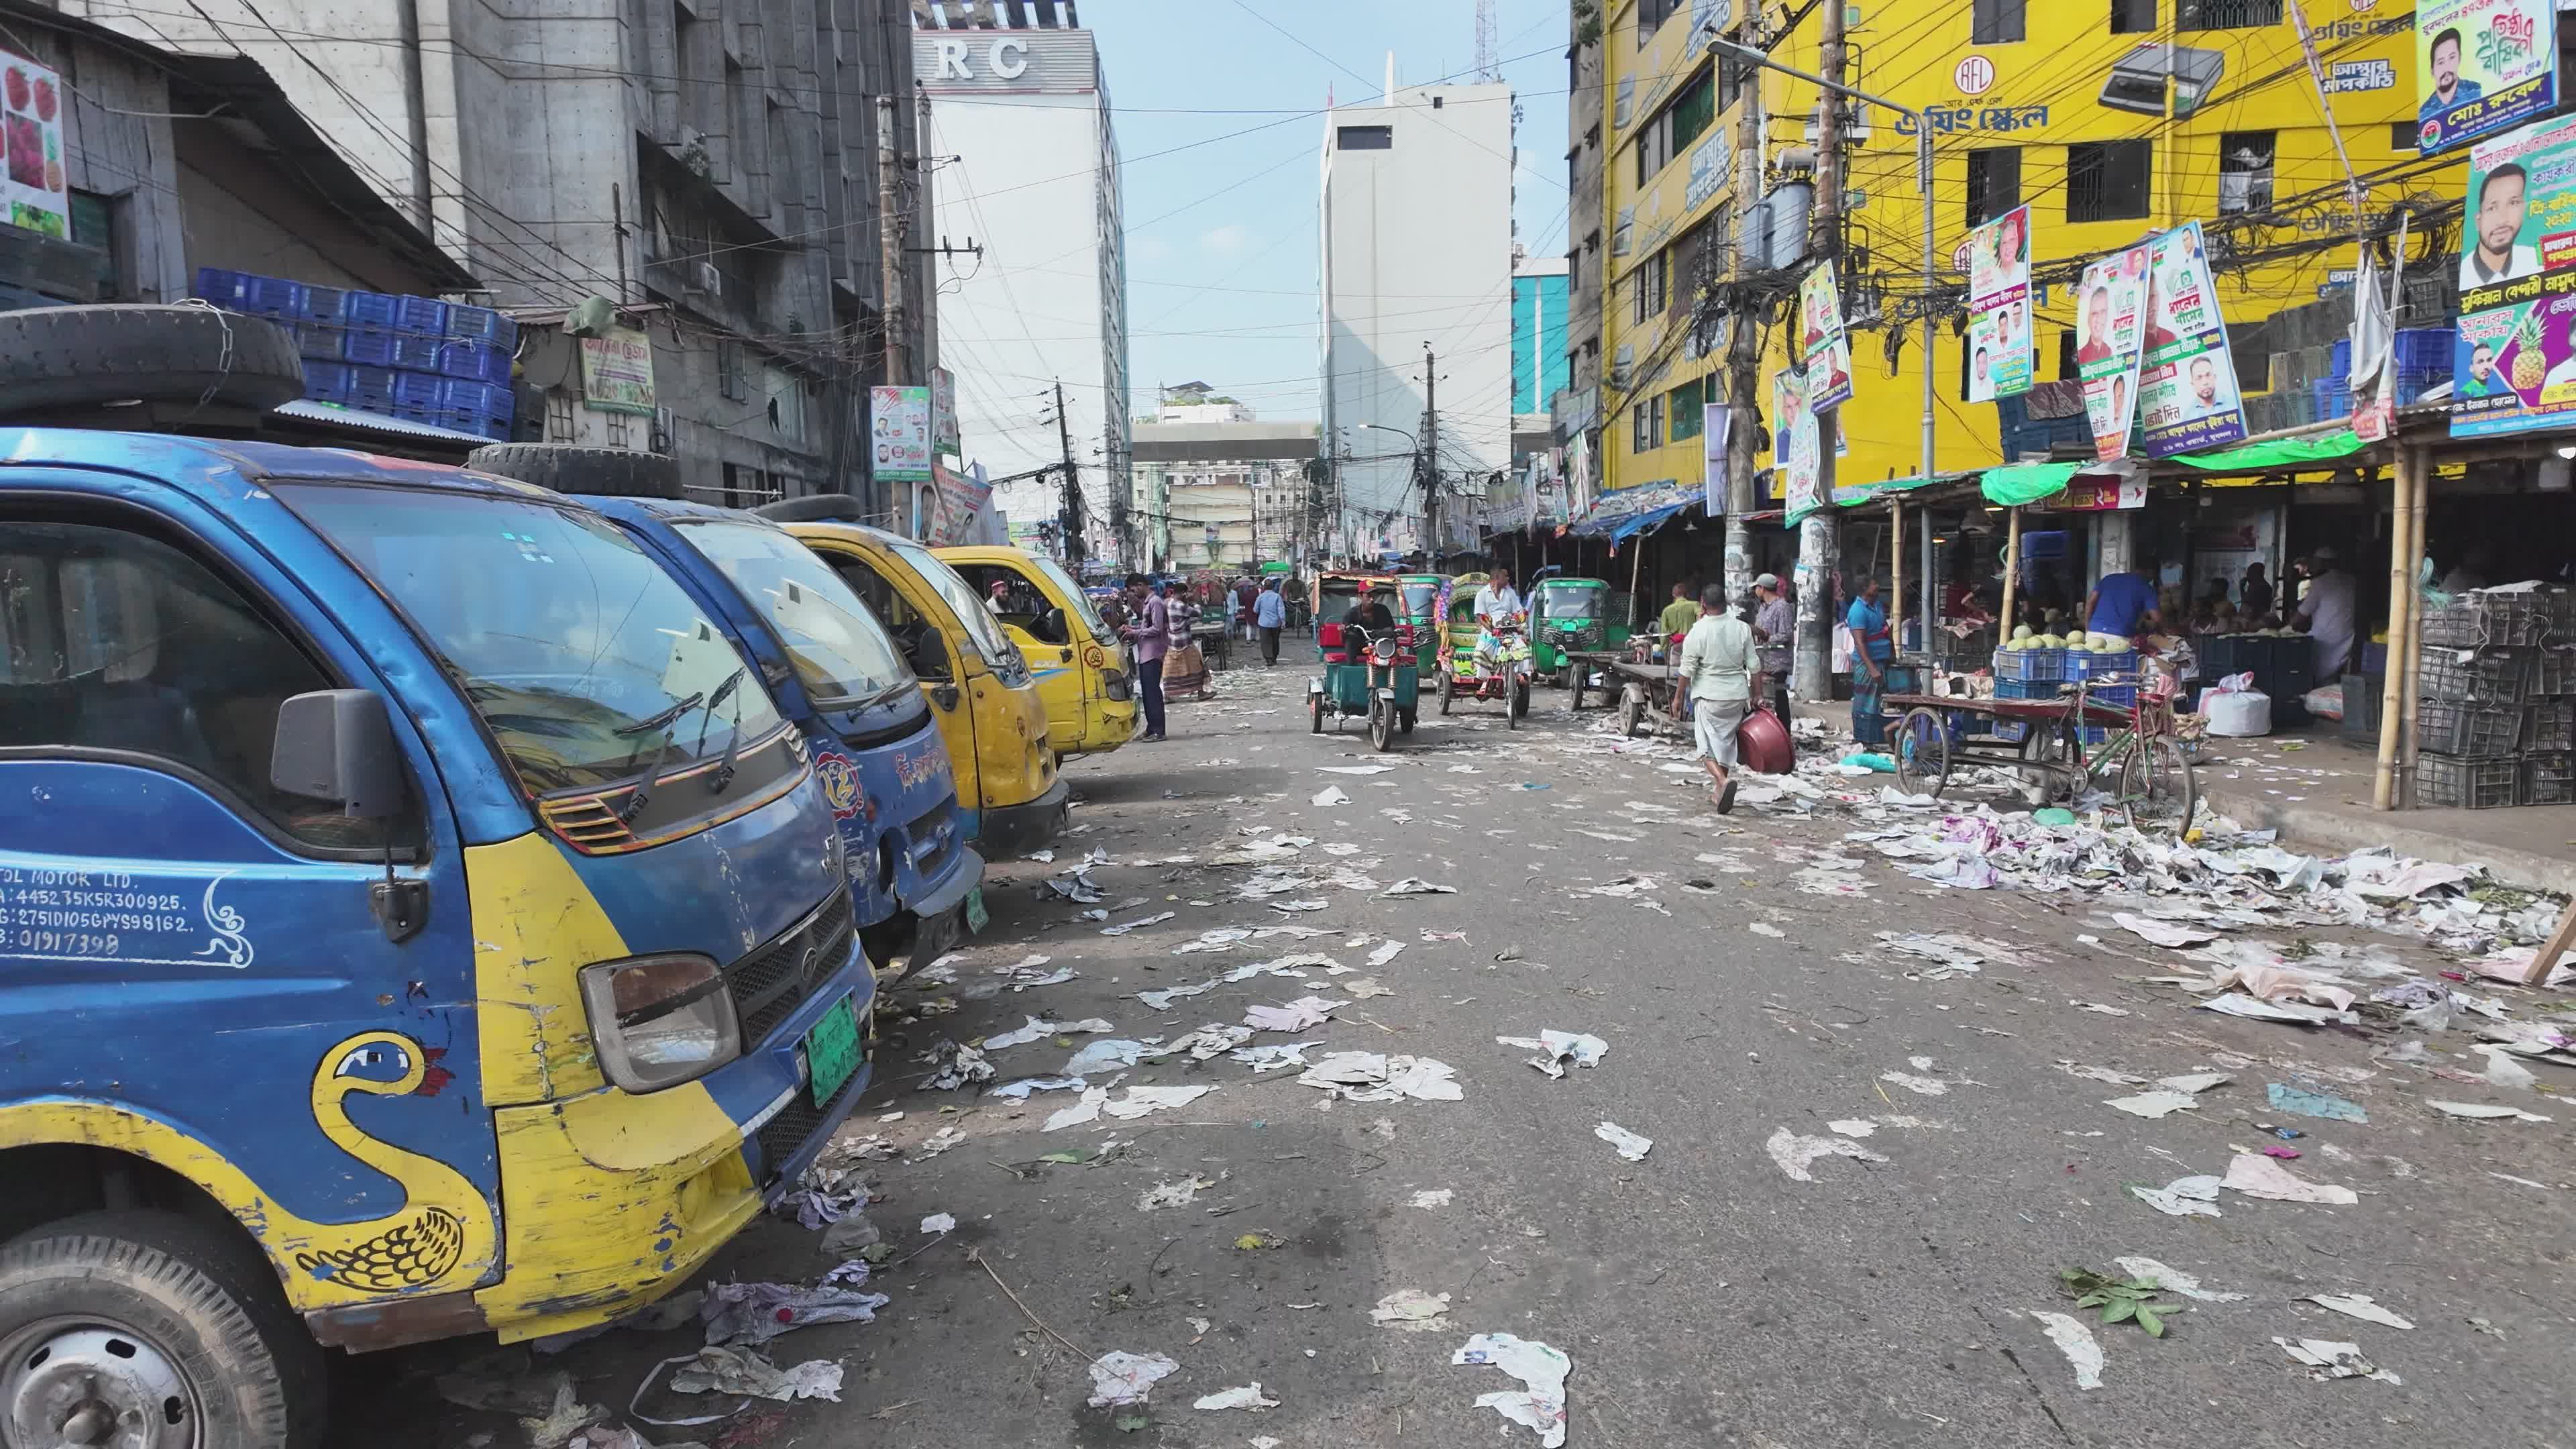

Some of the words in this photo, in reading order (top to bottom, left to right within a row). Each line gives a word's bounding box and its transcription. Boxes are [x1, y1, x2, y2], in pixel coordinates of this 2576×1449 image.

[1960, 58, 1989, 92] RFL
[2334, 60, 2388, 76] আস্থার
[2323, 70, 2394, 92] মাপকাঠি
[1943, 99, 1962, 109] আর
[1966, 97, 1983, 107] এফ
[1986, 96, 2002, 105] এল
[2489, 78, 2544, 108] রুবেল
[1980, 105, 2048, 132] স্কেল
[2169, 293, 2200, 315] ধানের
[2461, 288, 2502, 313] সুফিয়ান
[2460, 311, 2513, 331] আনারস
[2164, 405, 2180, 422] দিন
[32, 870, 91, 887] MOTOR
[103, 873, 139, 889] LTD.
